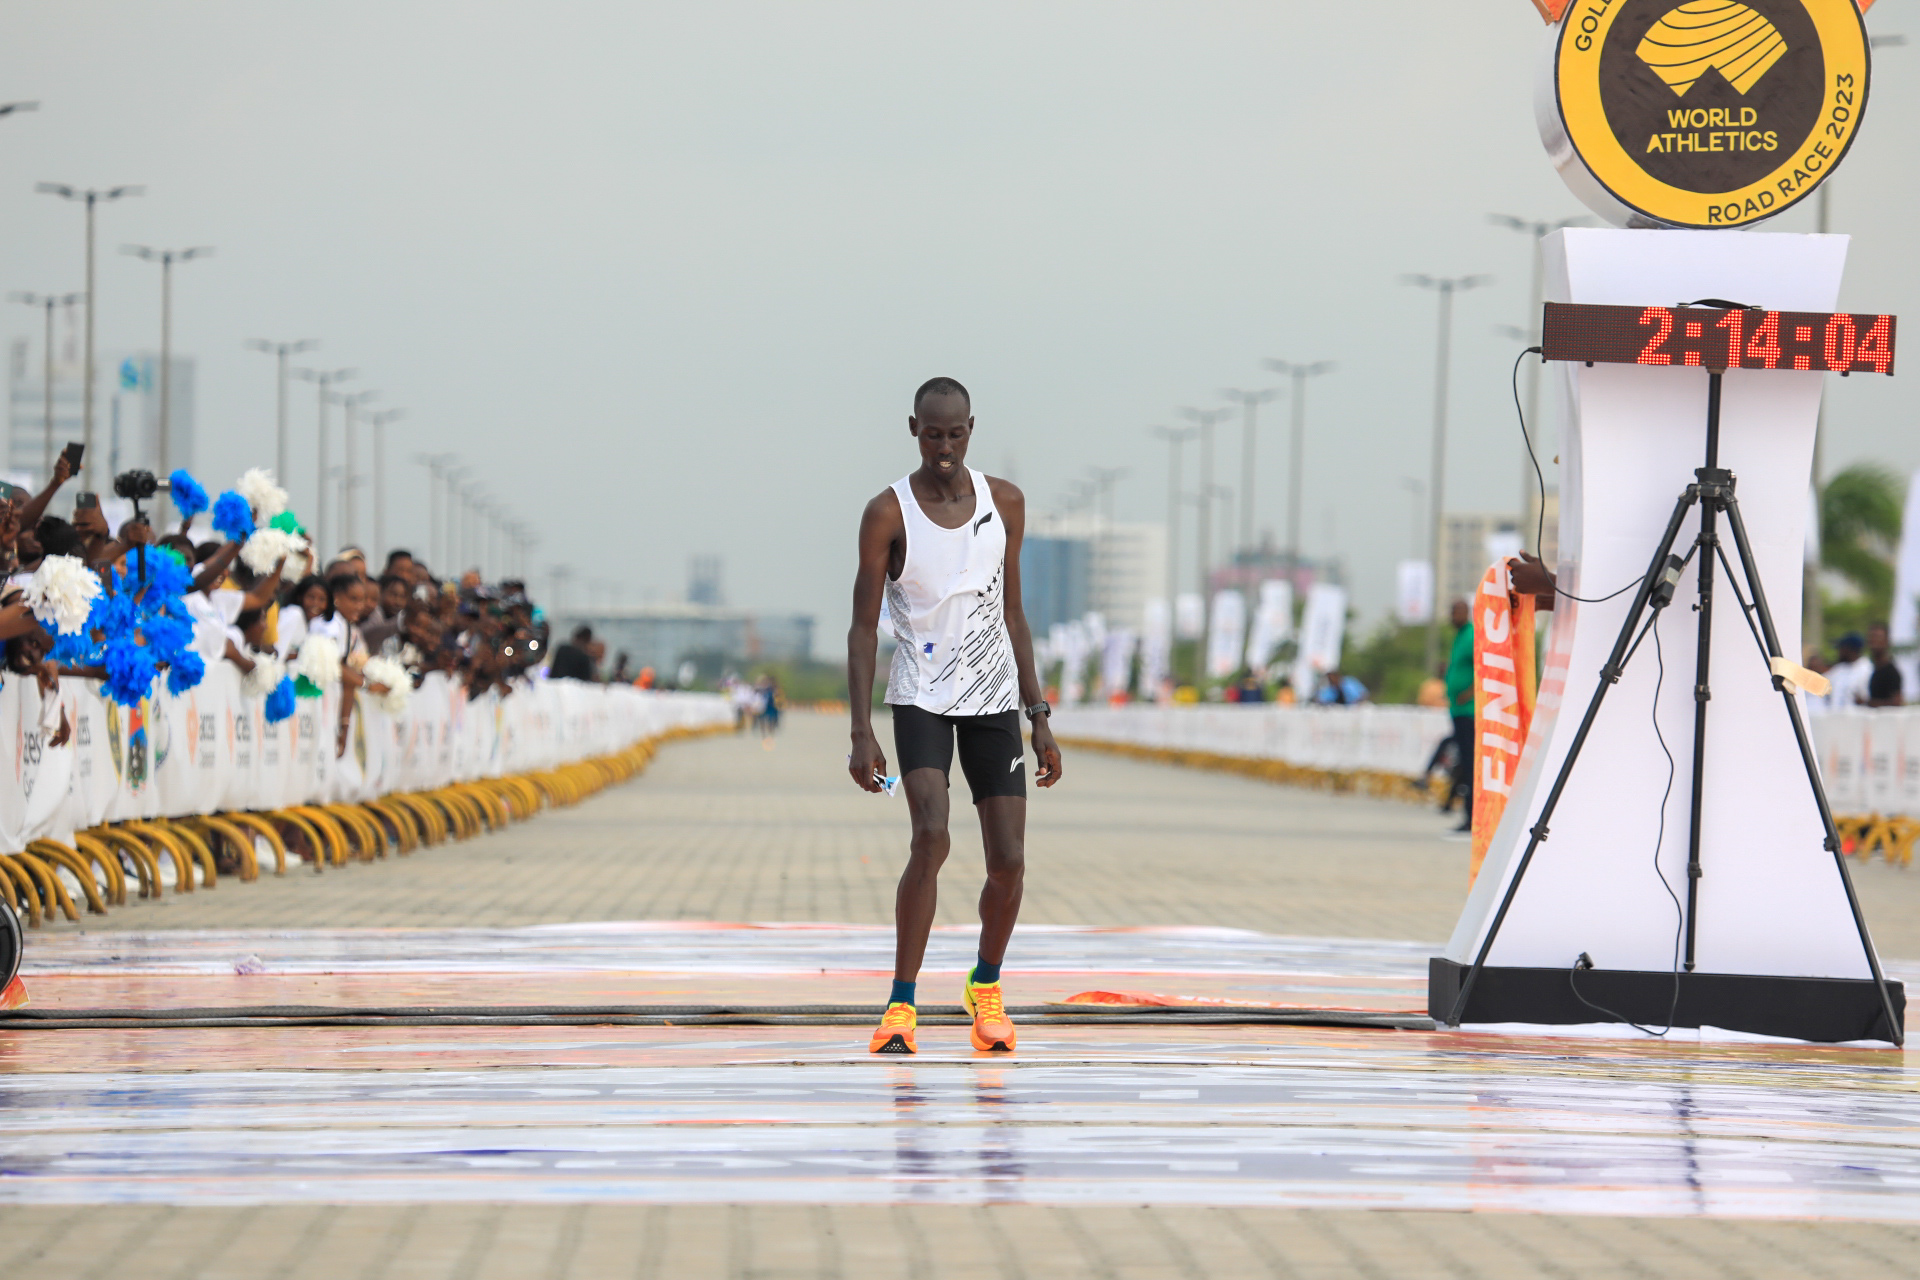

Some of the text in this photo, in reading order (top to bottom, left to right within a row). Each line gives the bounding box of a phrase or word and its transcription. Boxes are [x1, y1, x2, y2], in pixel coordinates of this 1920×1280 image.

[1667, 107, 1757, 129] WORLD
[1646, 131, 1778, 154] ATHLETICS
[1708, 73, 1854, 223] ROAD RACE 2023
[1637, 306, 1892, 373] 2:14:04
